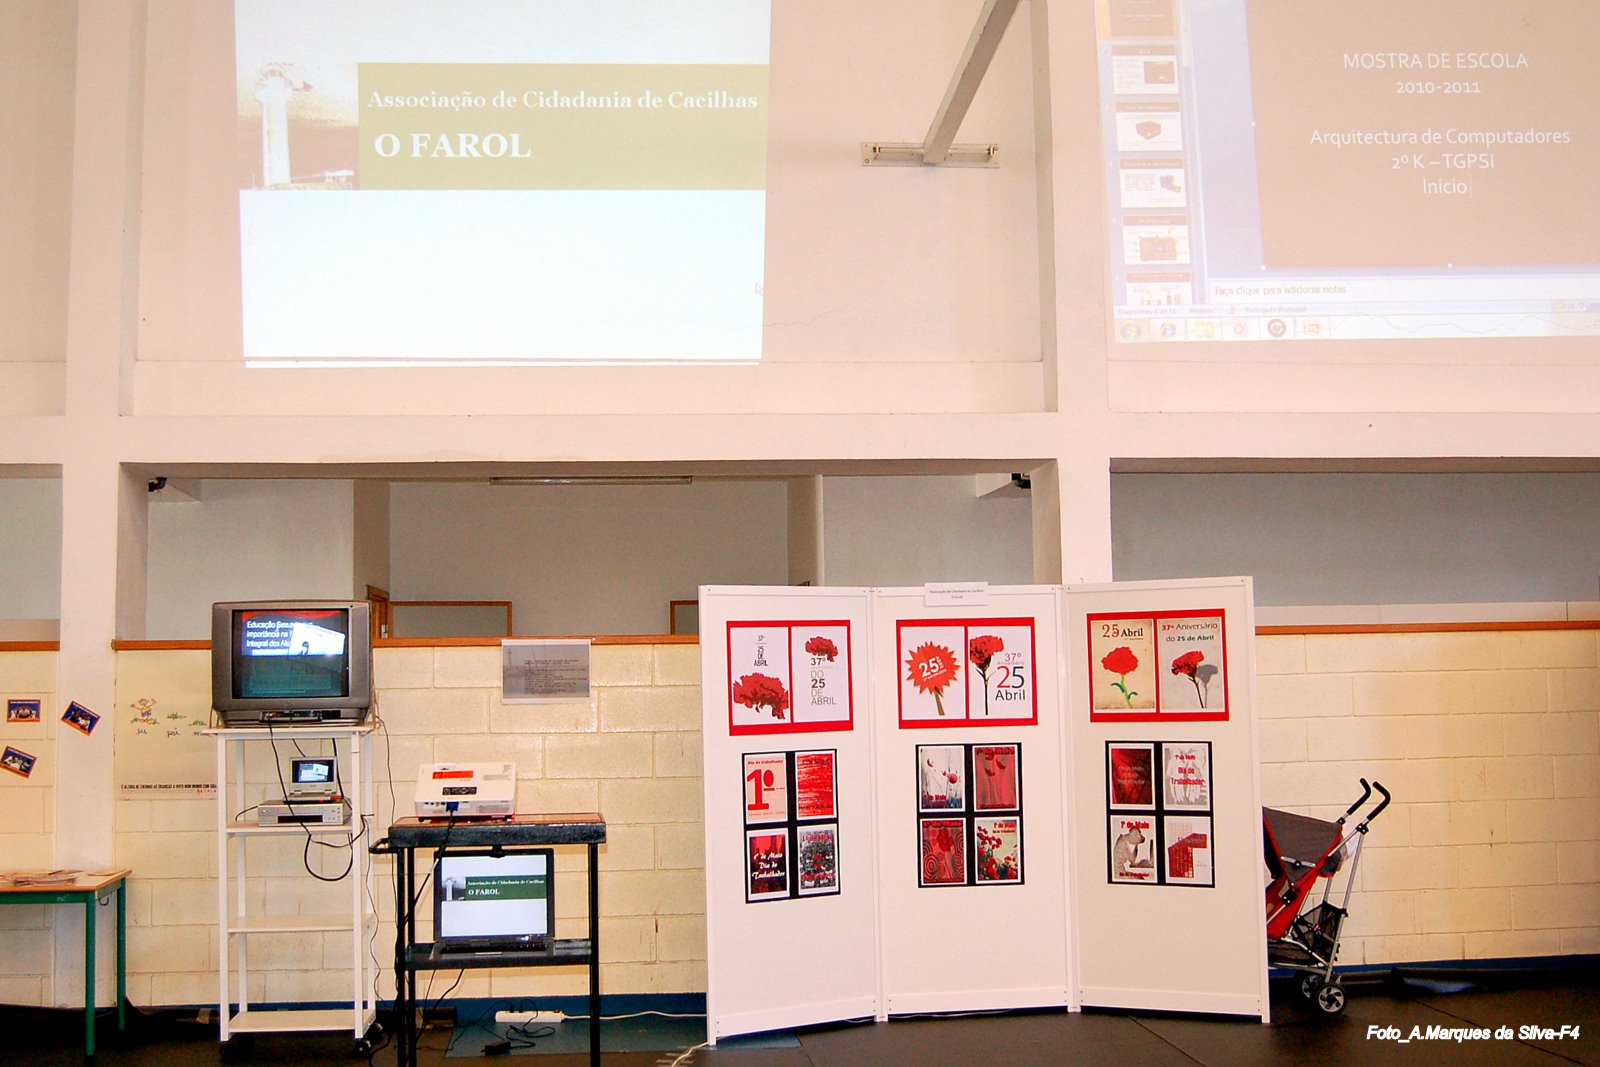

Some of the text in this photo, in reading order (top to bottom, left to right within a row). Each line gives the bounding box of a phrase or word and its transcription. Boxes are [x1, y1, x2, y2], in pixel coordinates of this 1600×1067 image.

[1343, 52, 1529, 69] MOSTRA DE ESCOLA
[1396, 80, 1481, 94] 2010-2011
[367, 90, 758, 113] Associação de Cidadania de Cacilhas
[1310, 128, 1571, 149] Arquitectura de Computadores
[374, 132, 532, 159] O FAROL
[1412, 154, 1426, 169] K
[1263, 286, 1282, 296] para
[1323, 284, 1346, 294] notas
[247, 620, 275, 631] Educação
[1102, 623, 1143, 638] 25 Abril
[1176, 622, 1218, 631] Aniversário
[918, 656, 940, 678] 25
[810, 670, 824, 679] DO
[996, 665, 1025, 689] 25
[811, 678, 826, 689] 25
[811, 688, 823, 698] DE
[994, 688, 1026, 701] Abril
[811, 696, 837, 706] ABRIL
[475, 888, 501, 896] FAROL
